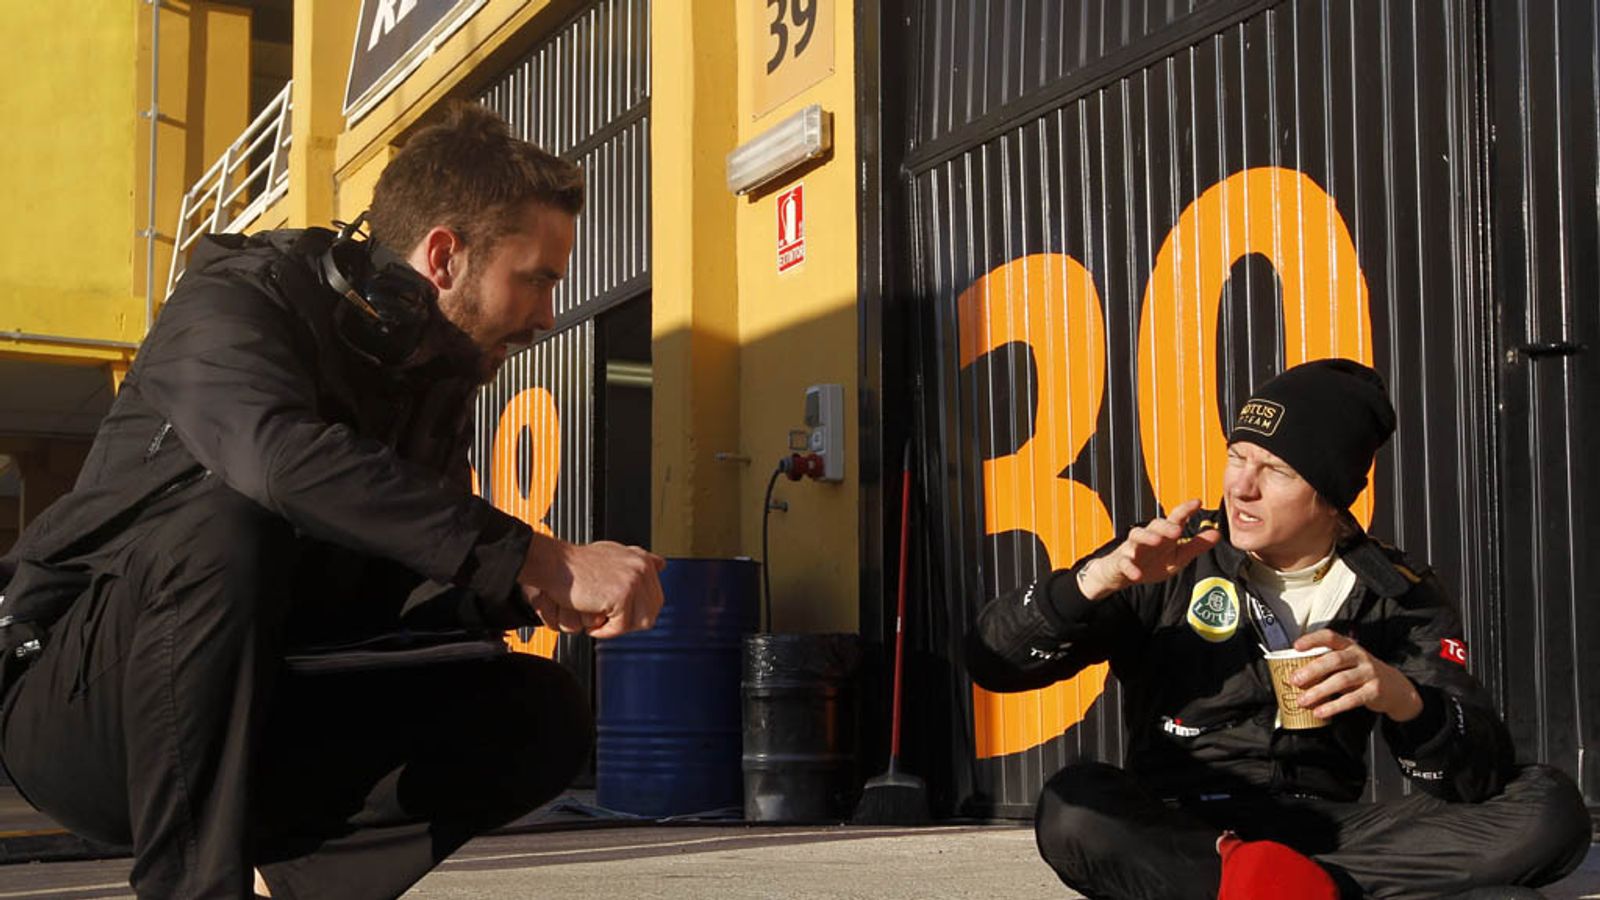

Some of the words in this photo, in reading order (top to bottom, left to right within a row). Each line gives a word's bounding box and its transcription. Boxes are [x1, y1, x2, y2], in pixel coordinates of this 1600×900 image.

[767, 0, 817, 75] 39
[471, 386, 560, 660] 8
[1193, 601, 1236, 624] LOTUS
